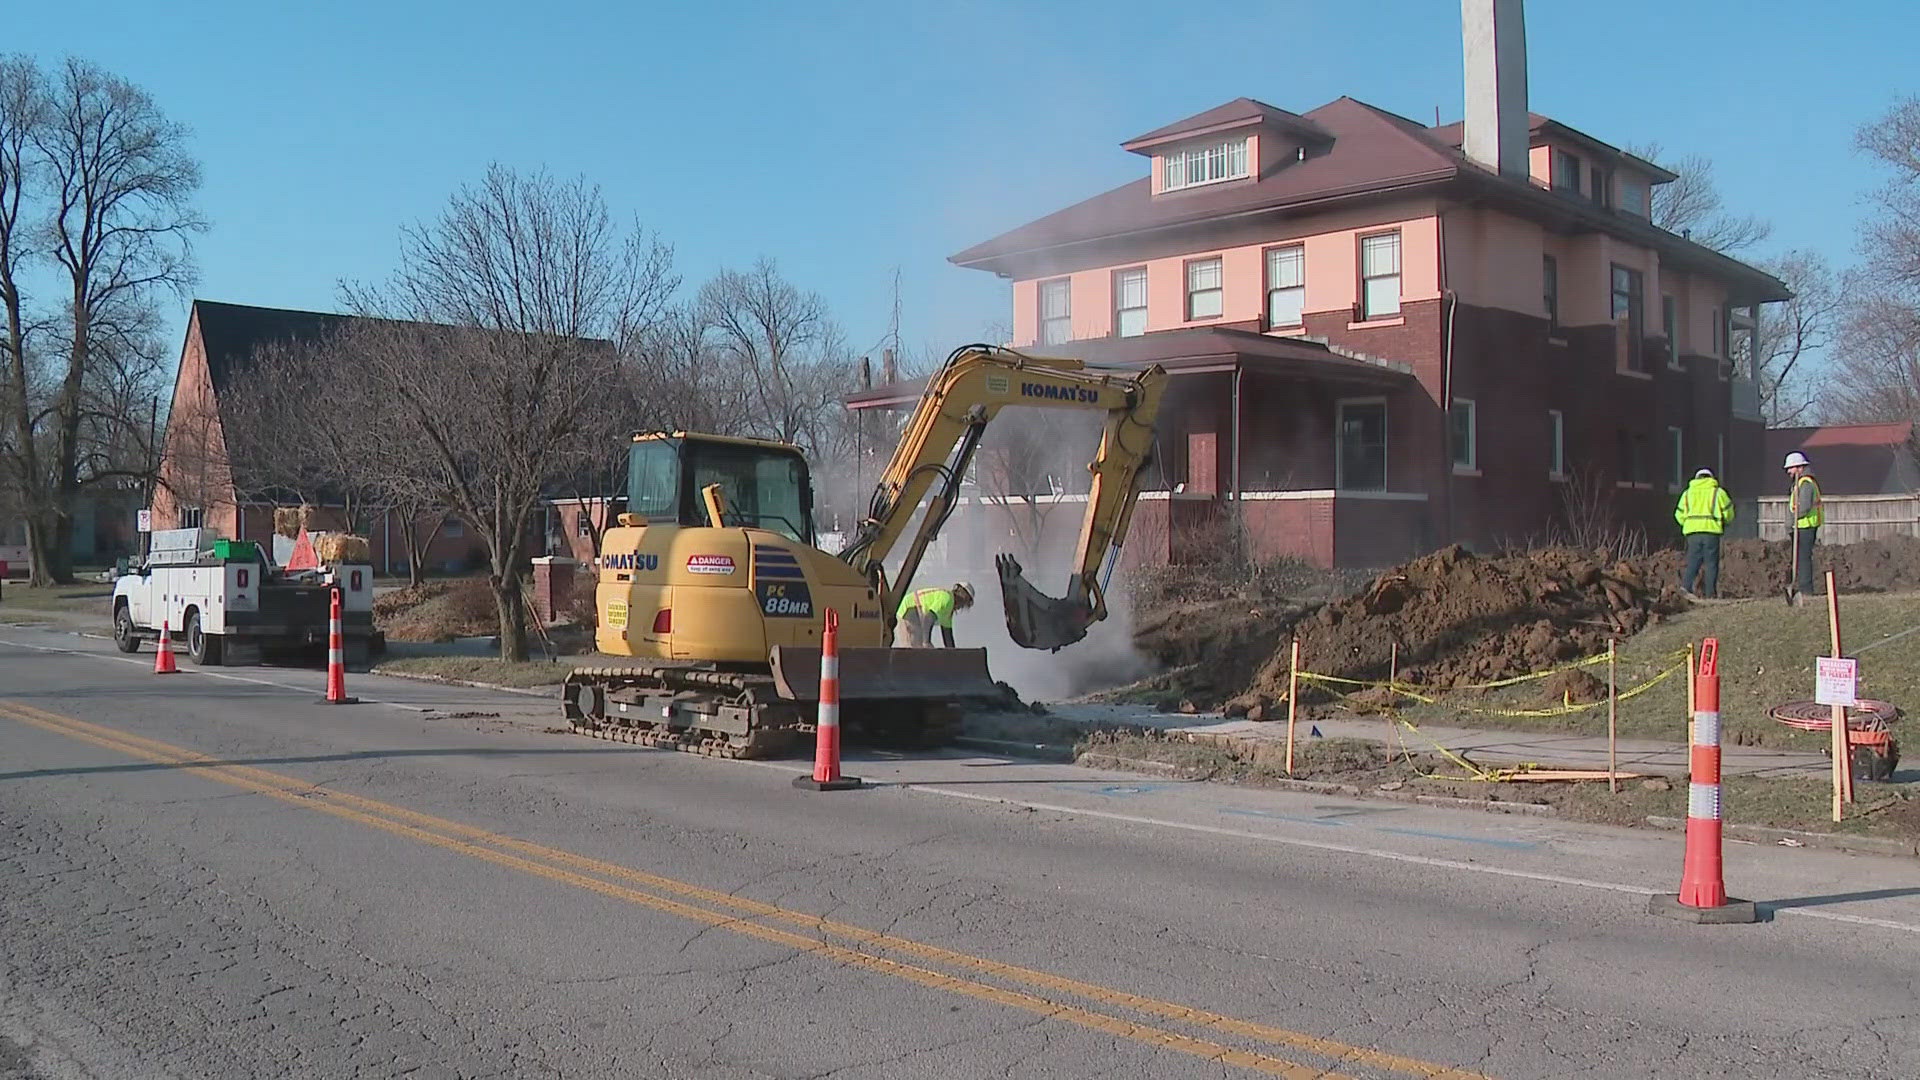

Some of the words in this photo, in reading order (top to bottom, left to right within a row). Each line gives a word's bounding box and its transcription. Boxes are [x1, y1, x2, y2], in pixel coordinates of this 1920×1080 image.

[1021, 382, 1098, 403] KOMATSU
[698, 556, 731, 566] DANGER
[766, 585, 786, 597] PC
[765, 598, 809, 614] 88MR
